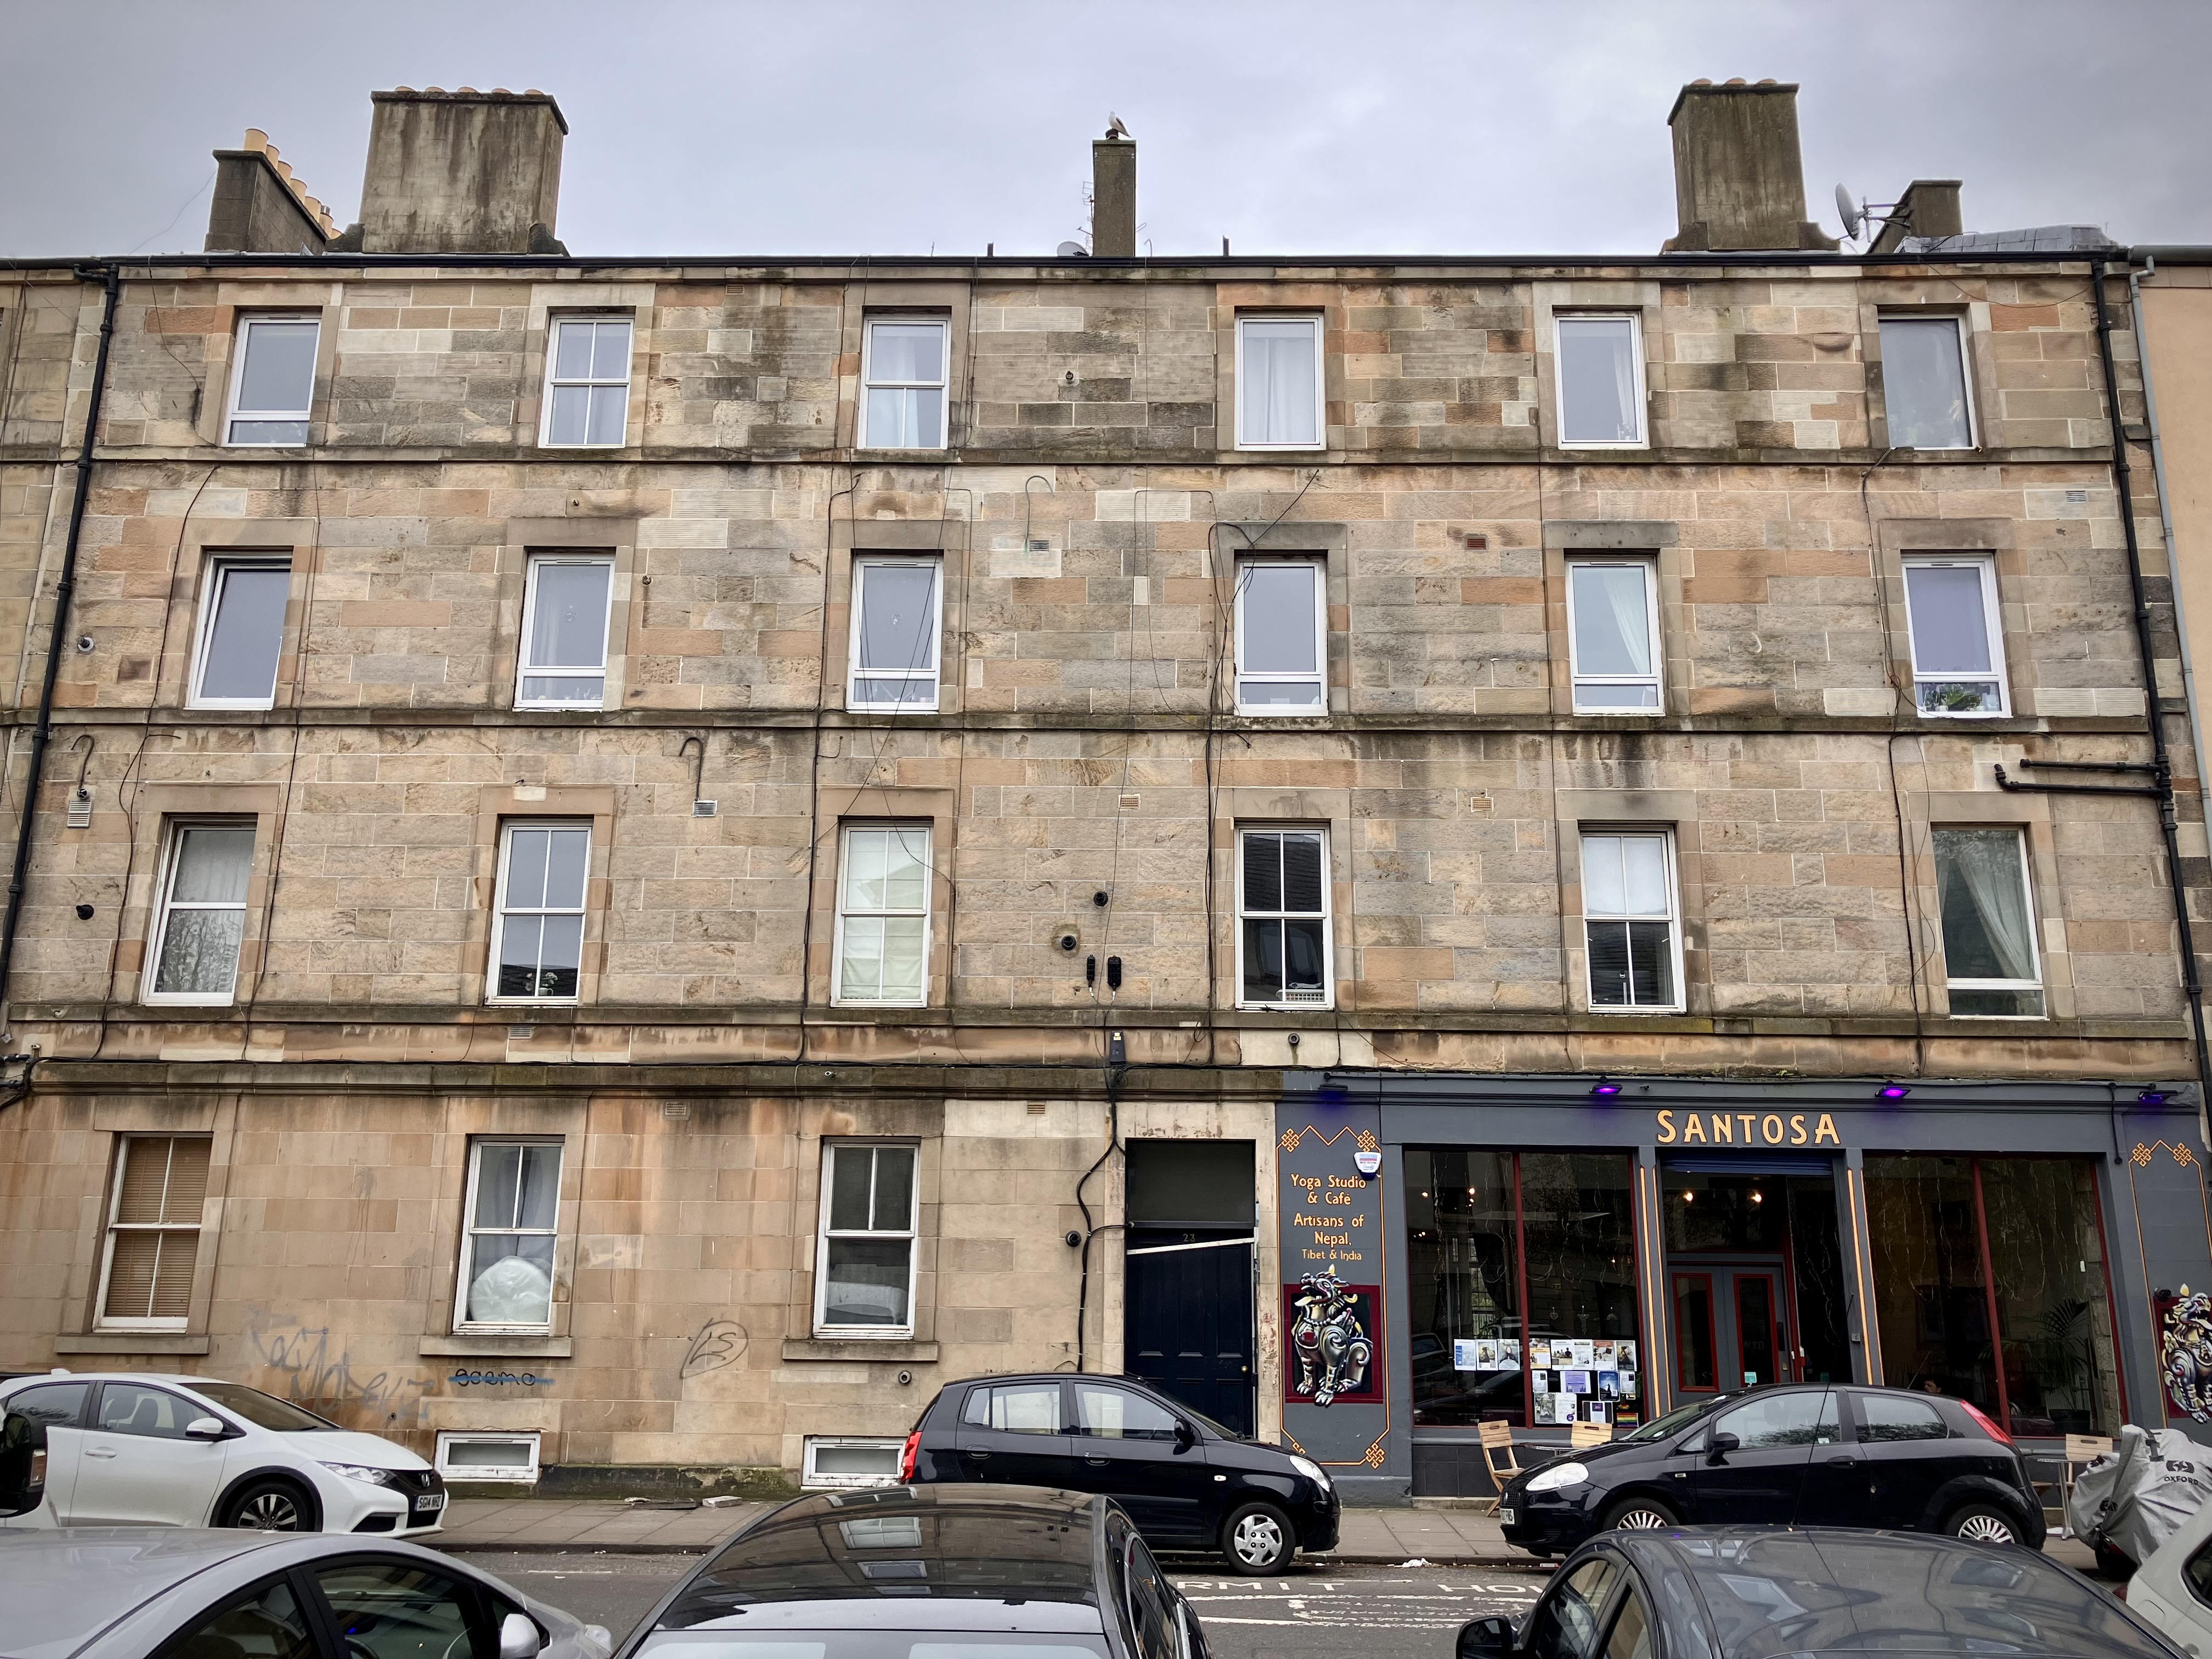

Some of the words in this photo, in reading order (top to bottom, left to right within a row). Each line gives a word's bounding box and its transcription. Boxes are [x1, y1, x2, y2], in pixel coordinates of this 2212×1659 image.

[1656, 1110, 1841, 1145] SANTOSA
[1290, 1173, 1322, 1190] Yoga
[1328, 1174, 1367, 1189] Studio
[1307, 1191, 1318, 1204] &
[1325, 1191, 1352, 1205] Café
[1294, 1212, 1344, 1228] Artisans
[1351, 1214, 1364, 1227] of
[1182, 1233, 1195, 1243] 23
[1314, 1231, 1352, 1248] Nepal,
[1301, 1249, 1326, 1260] Tibet
[1329, 1249, 1338, 1260] &
[1340, 1250, 1362, 1261] India
[2164, 1475, 2199, 1486] OXFORD
[1177, 1581, 1346, 1592] RMIT
